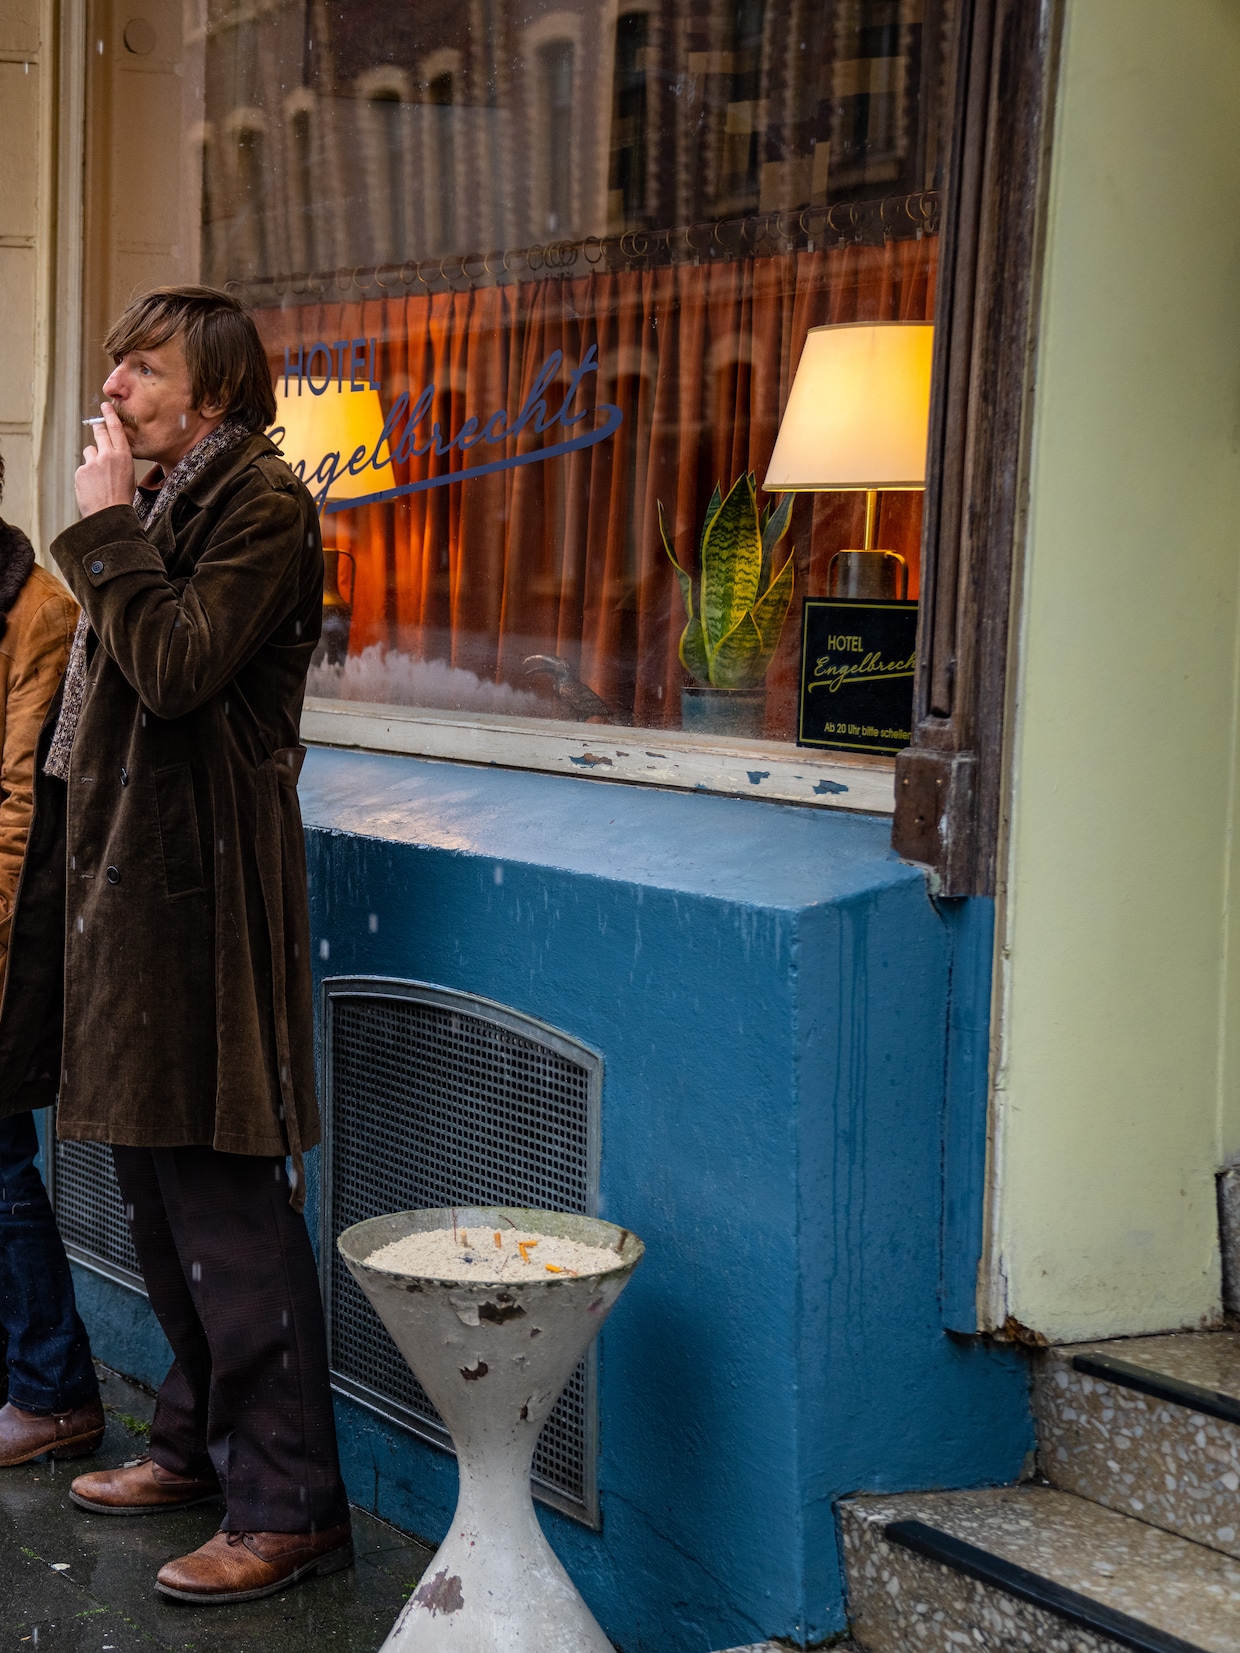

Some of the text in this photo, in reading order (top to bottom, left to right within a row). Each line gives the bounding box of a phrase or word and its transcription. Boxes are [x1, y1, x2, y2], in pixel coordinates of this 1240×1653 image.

[284, 338, 381, 398] HOTEL
[827, 634, 864, 652] HOTEL
[813, 651, 916, 693] Engelbrech
[824, 721, 835, 733] Ab
[836, 723, 847, 734] 20
[847, 724, 861, 735] Uhr
[861, 725, 879, 737] bitte
